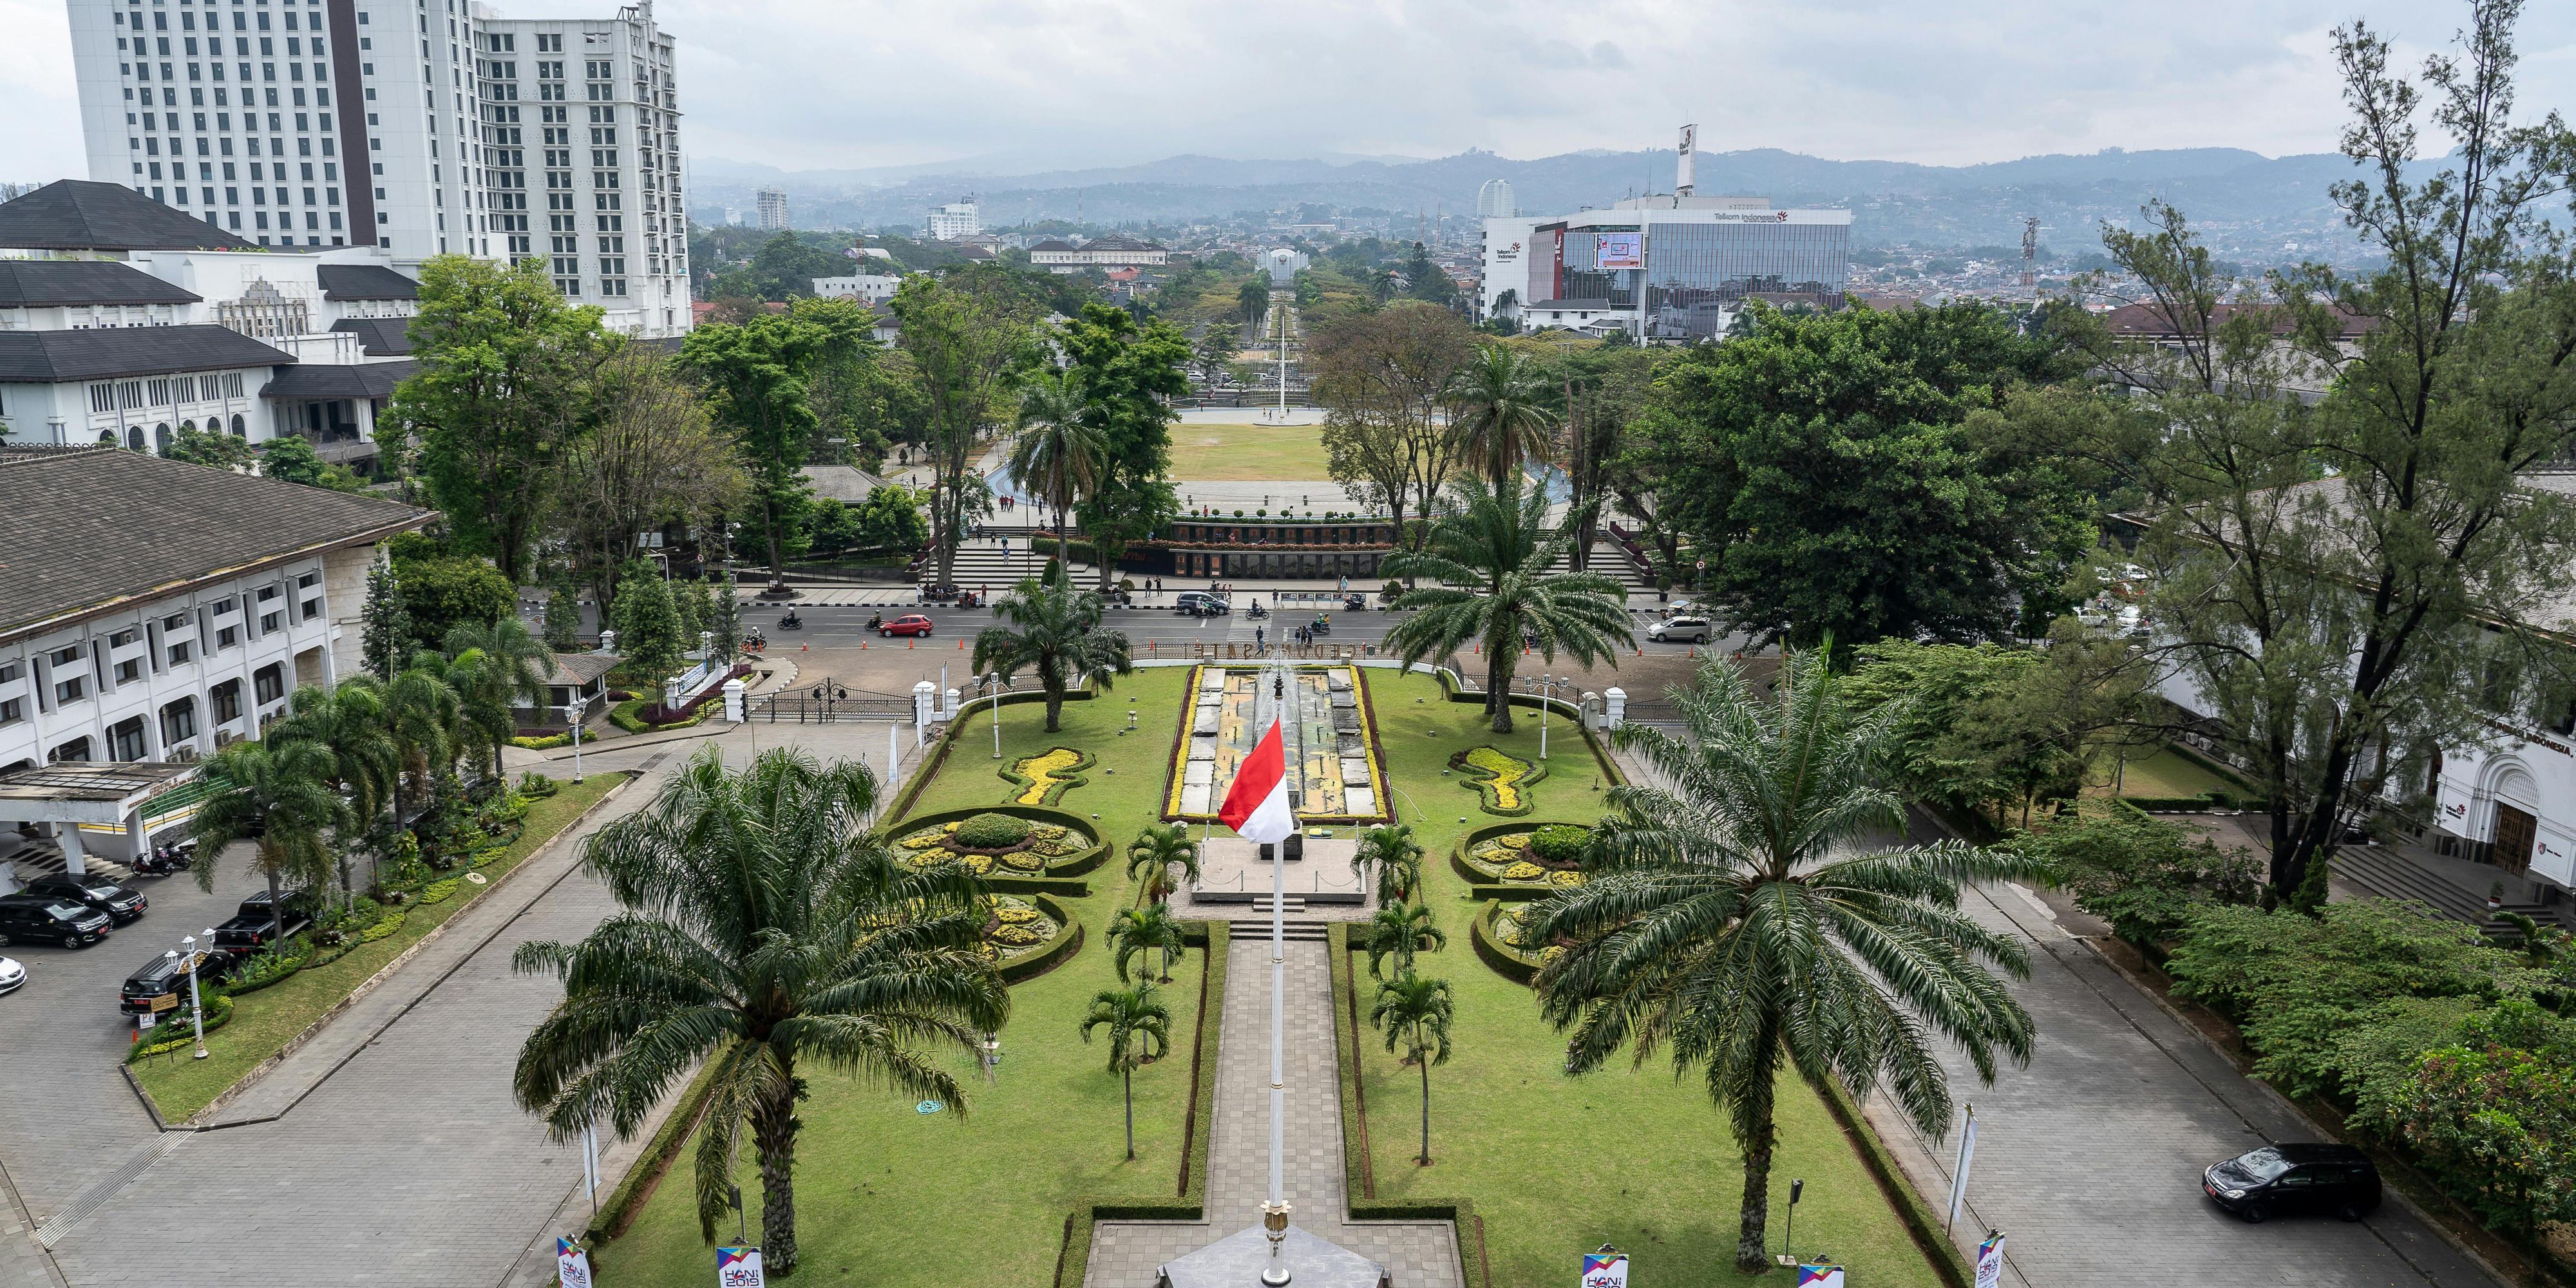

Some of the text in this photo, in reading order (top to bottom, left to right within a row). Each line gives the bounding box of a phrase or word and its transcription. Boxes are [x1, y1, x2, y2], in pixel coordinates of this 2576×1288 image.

[562, 1259, 585, 1277] HANI
[724, 1269, 759, 1279] HANI
[1978, 1264, 1998, 1280] 209
[564, 1267, 586, 1284] 2019
[1587, 1276, 1622, 1286] HANI
[726, 1278, 759, 1287] 2019
